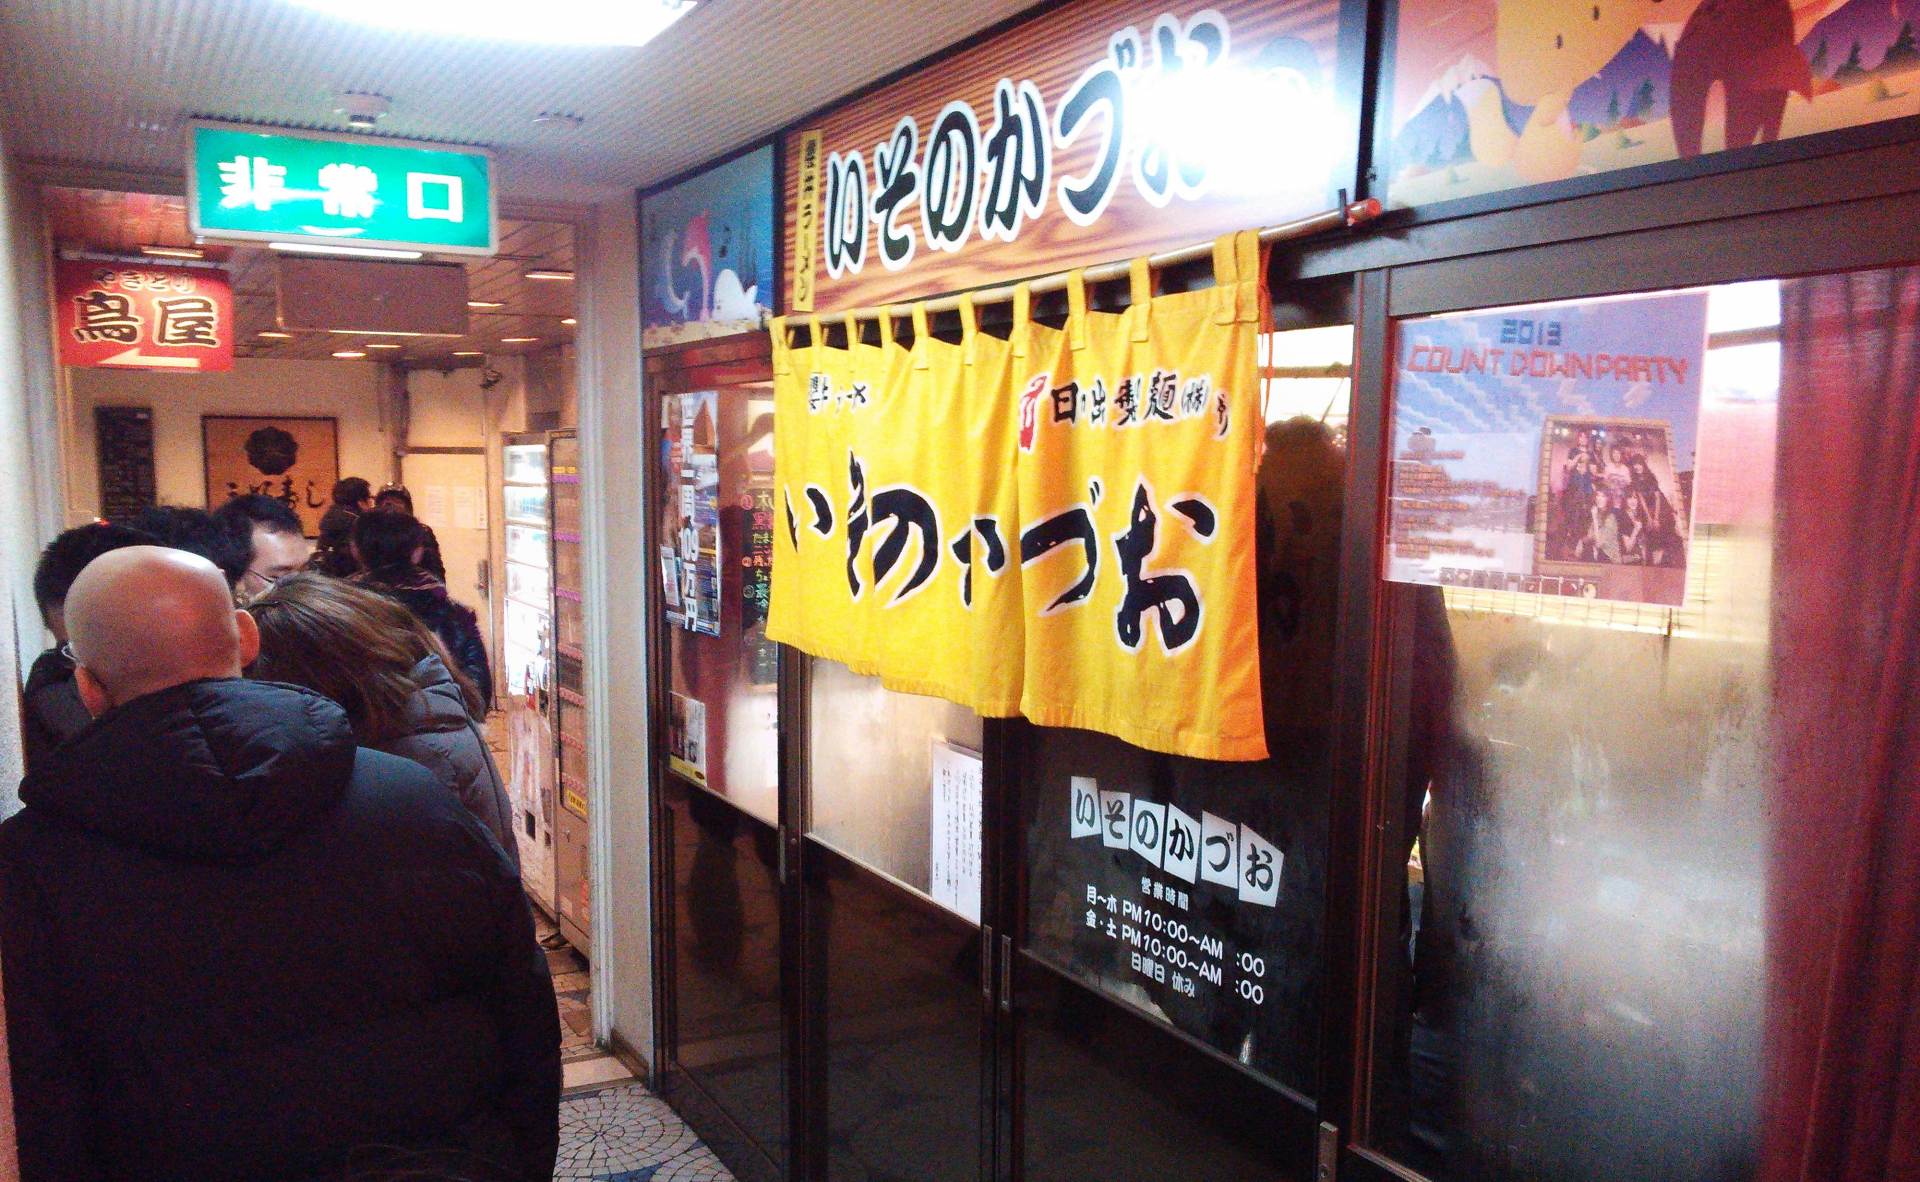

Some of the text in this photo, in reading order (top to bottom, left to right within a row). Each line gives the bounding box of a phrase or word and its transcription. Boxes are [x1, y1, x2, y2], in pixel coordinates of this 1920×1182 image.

[217, 154, 464, 224] 非常口
[74, 291, 219, 347] 鳥屋
[1500, 318, 1561, 346] 2013
[1406, 343, 1690, 385] COUNT DOWN PARTY
[1076, 788, 1274, 892] いそのかづお
[1140, 876, 1189, 912] 営業時間
[1131, 951, 1196, 998] 日曜日 休み
